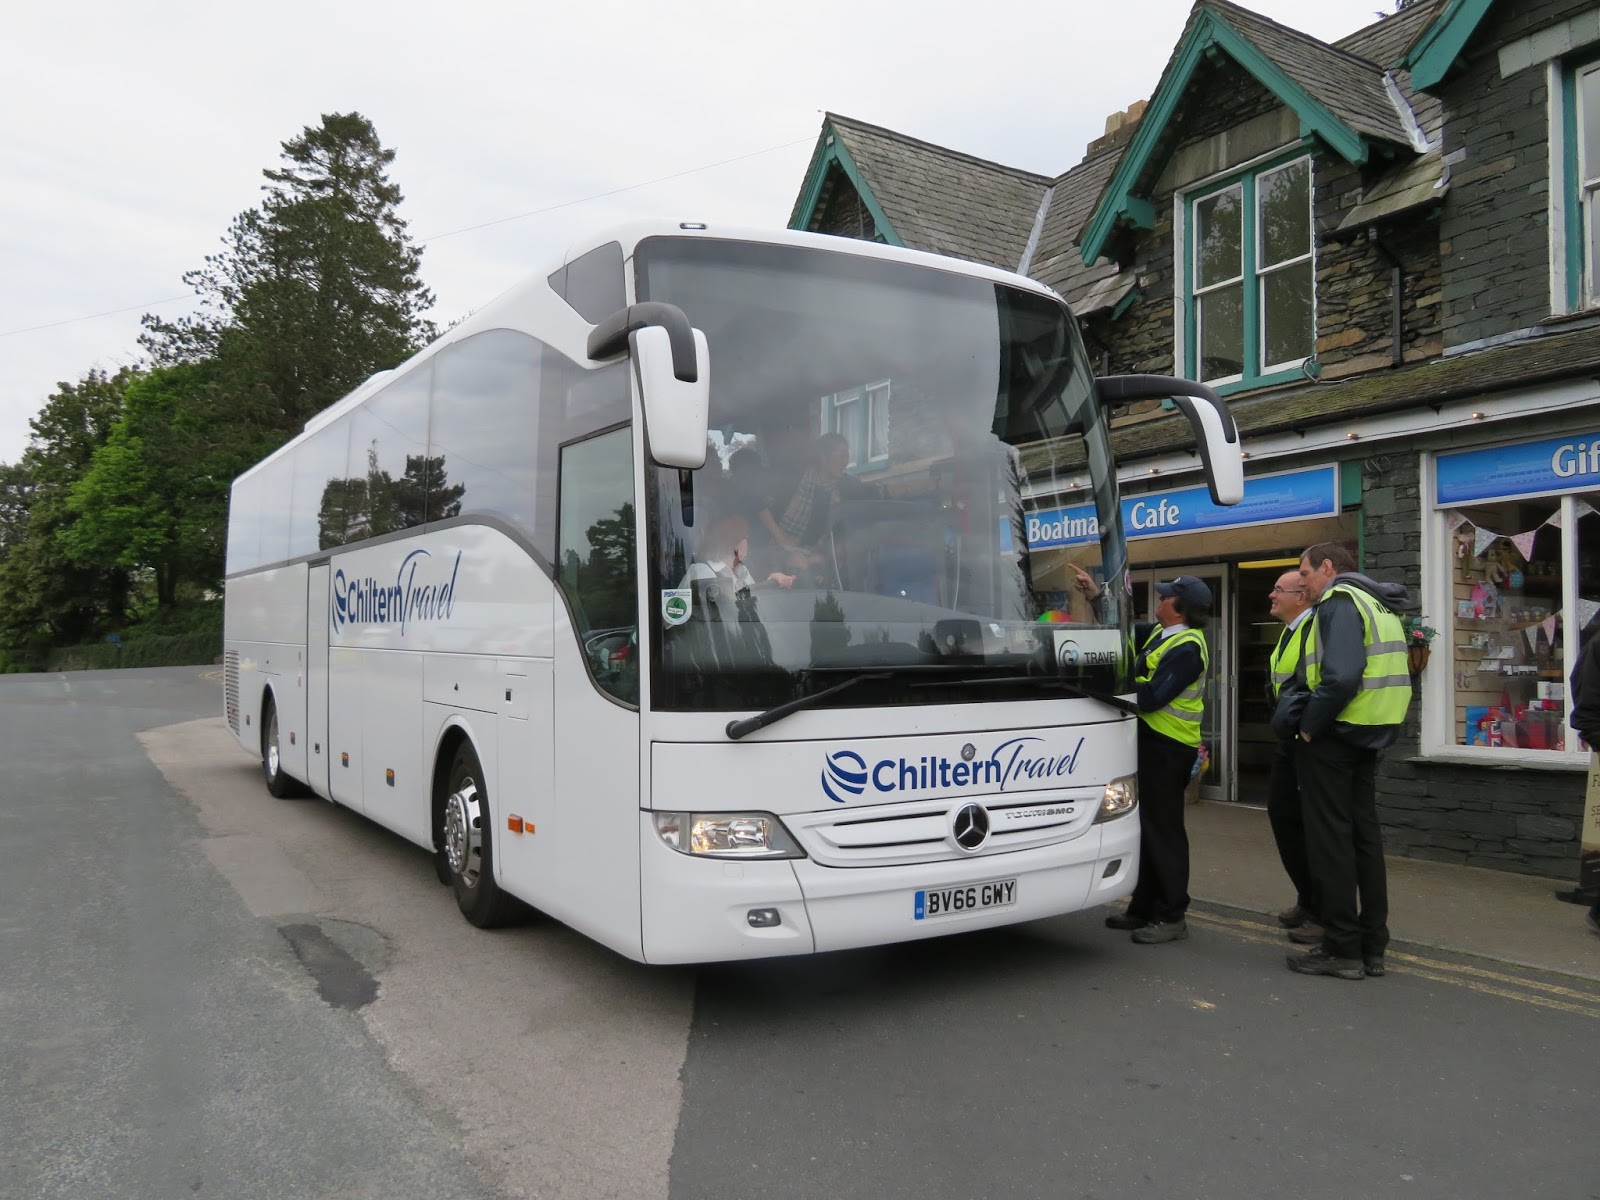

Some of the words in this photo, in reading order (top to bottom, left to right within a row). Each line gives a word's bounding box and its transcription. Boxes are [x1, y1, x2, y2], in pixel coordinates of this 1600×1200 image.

[1551, 440, 1600, 478] Gif
[1028, 515, 1100, 543] Boatma
[1131, 498, 1180, 530] Cafe
[347, 577, 403, 624] Chiltern
[398, 549, 462, 637] Travel
[872, 756, 1001, 793] Chiltern
[991, 737, 1085, 791] Travel
[1005, 807, 1075, 820] TOURISMO
[928, 889, 977, 914] BV66
[981, 881, 1016, 906] GWY
